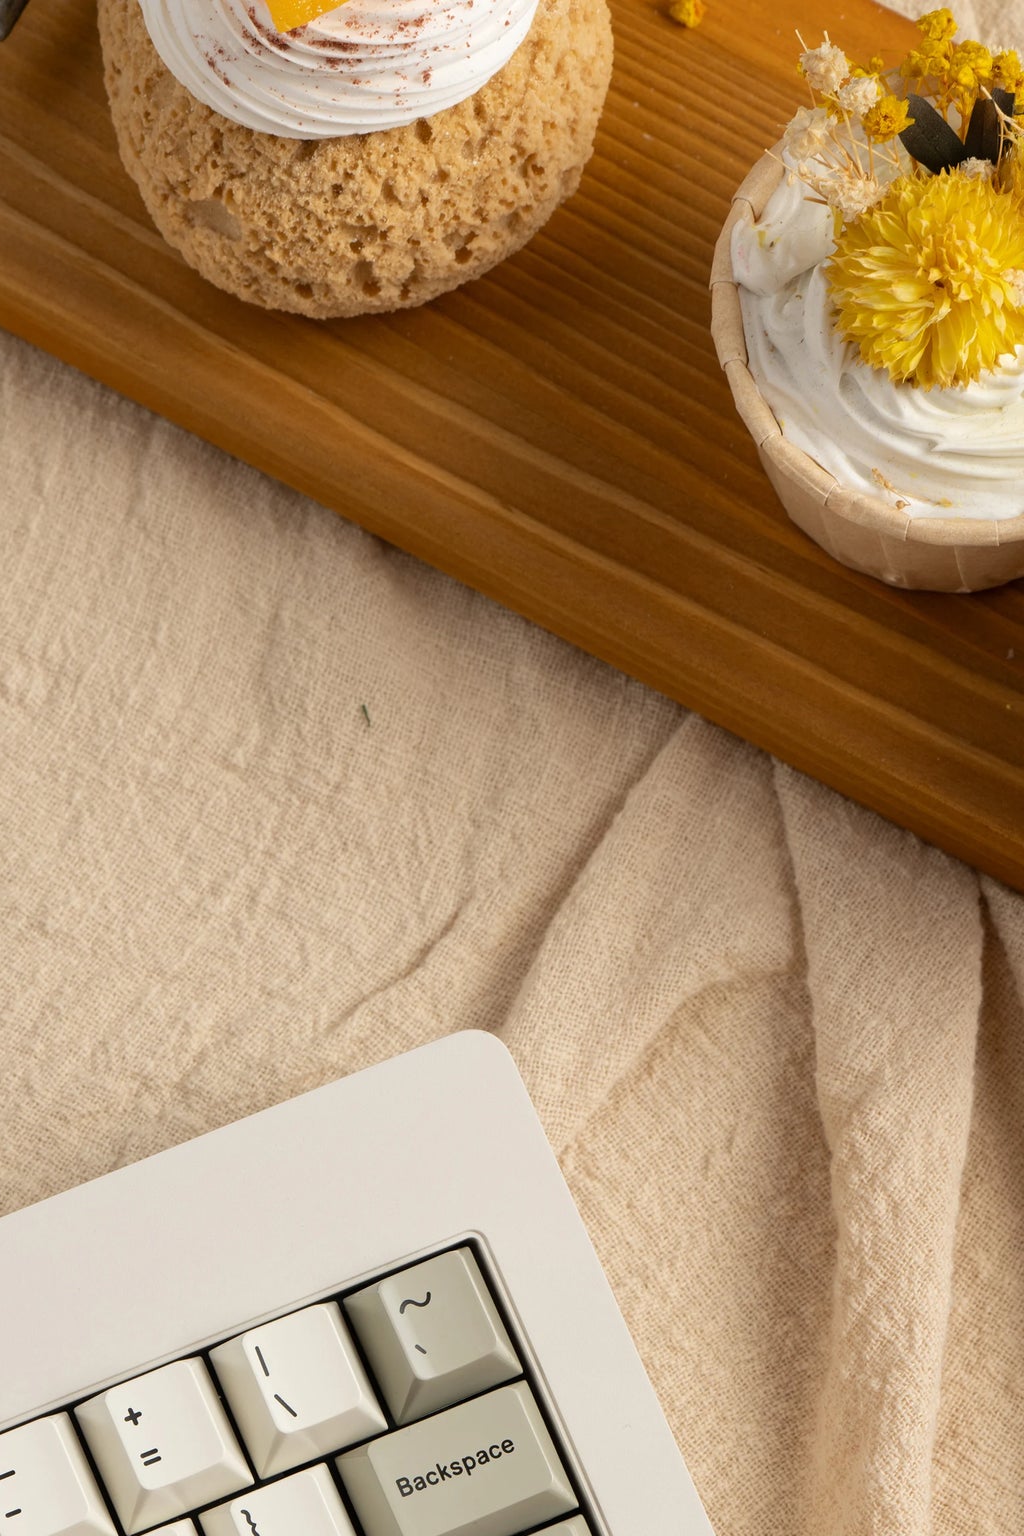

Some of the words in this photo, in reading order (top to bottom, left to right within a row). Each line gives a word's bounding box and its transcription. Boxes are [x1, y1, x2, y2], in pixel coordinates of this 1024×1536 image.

[400, 1292, 431, 1314] ~
[124, 1408, 142, 1425] +
[274, 1394, 297, 1417] \
[140, 1448, 161, 1466] =
[395, 1438, 514, 1497] Backspace
